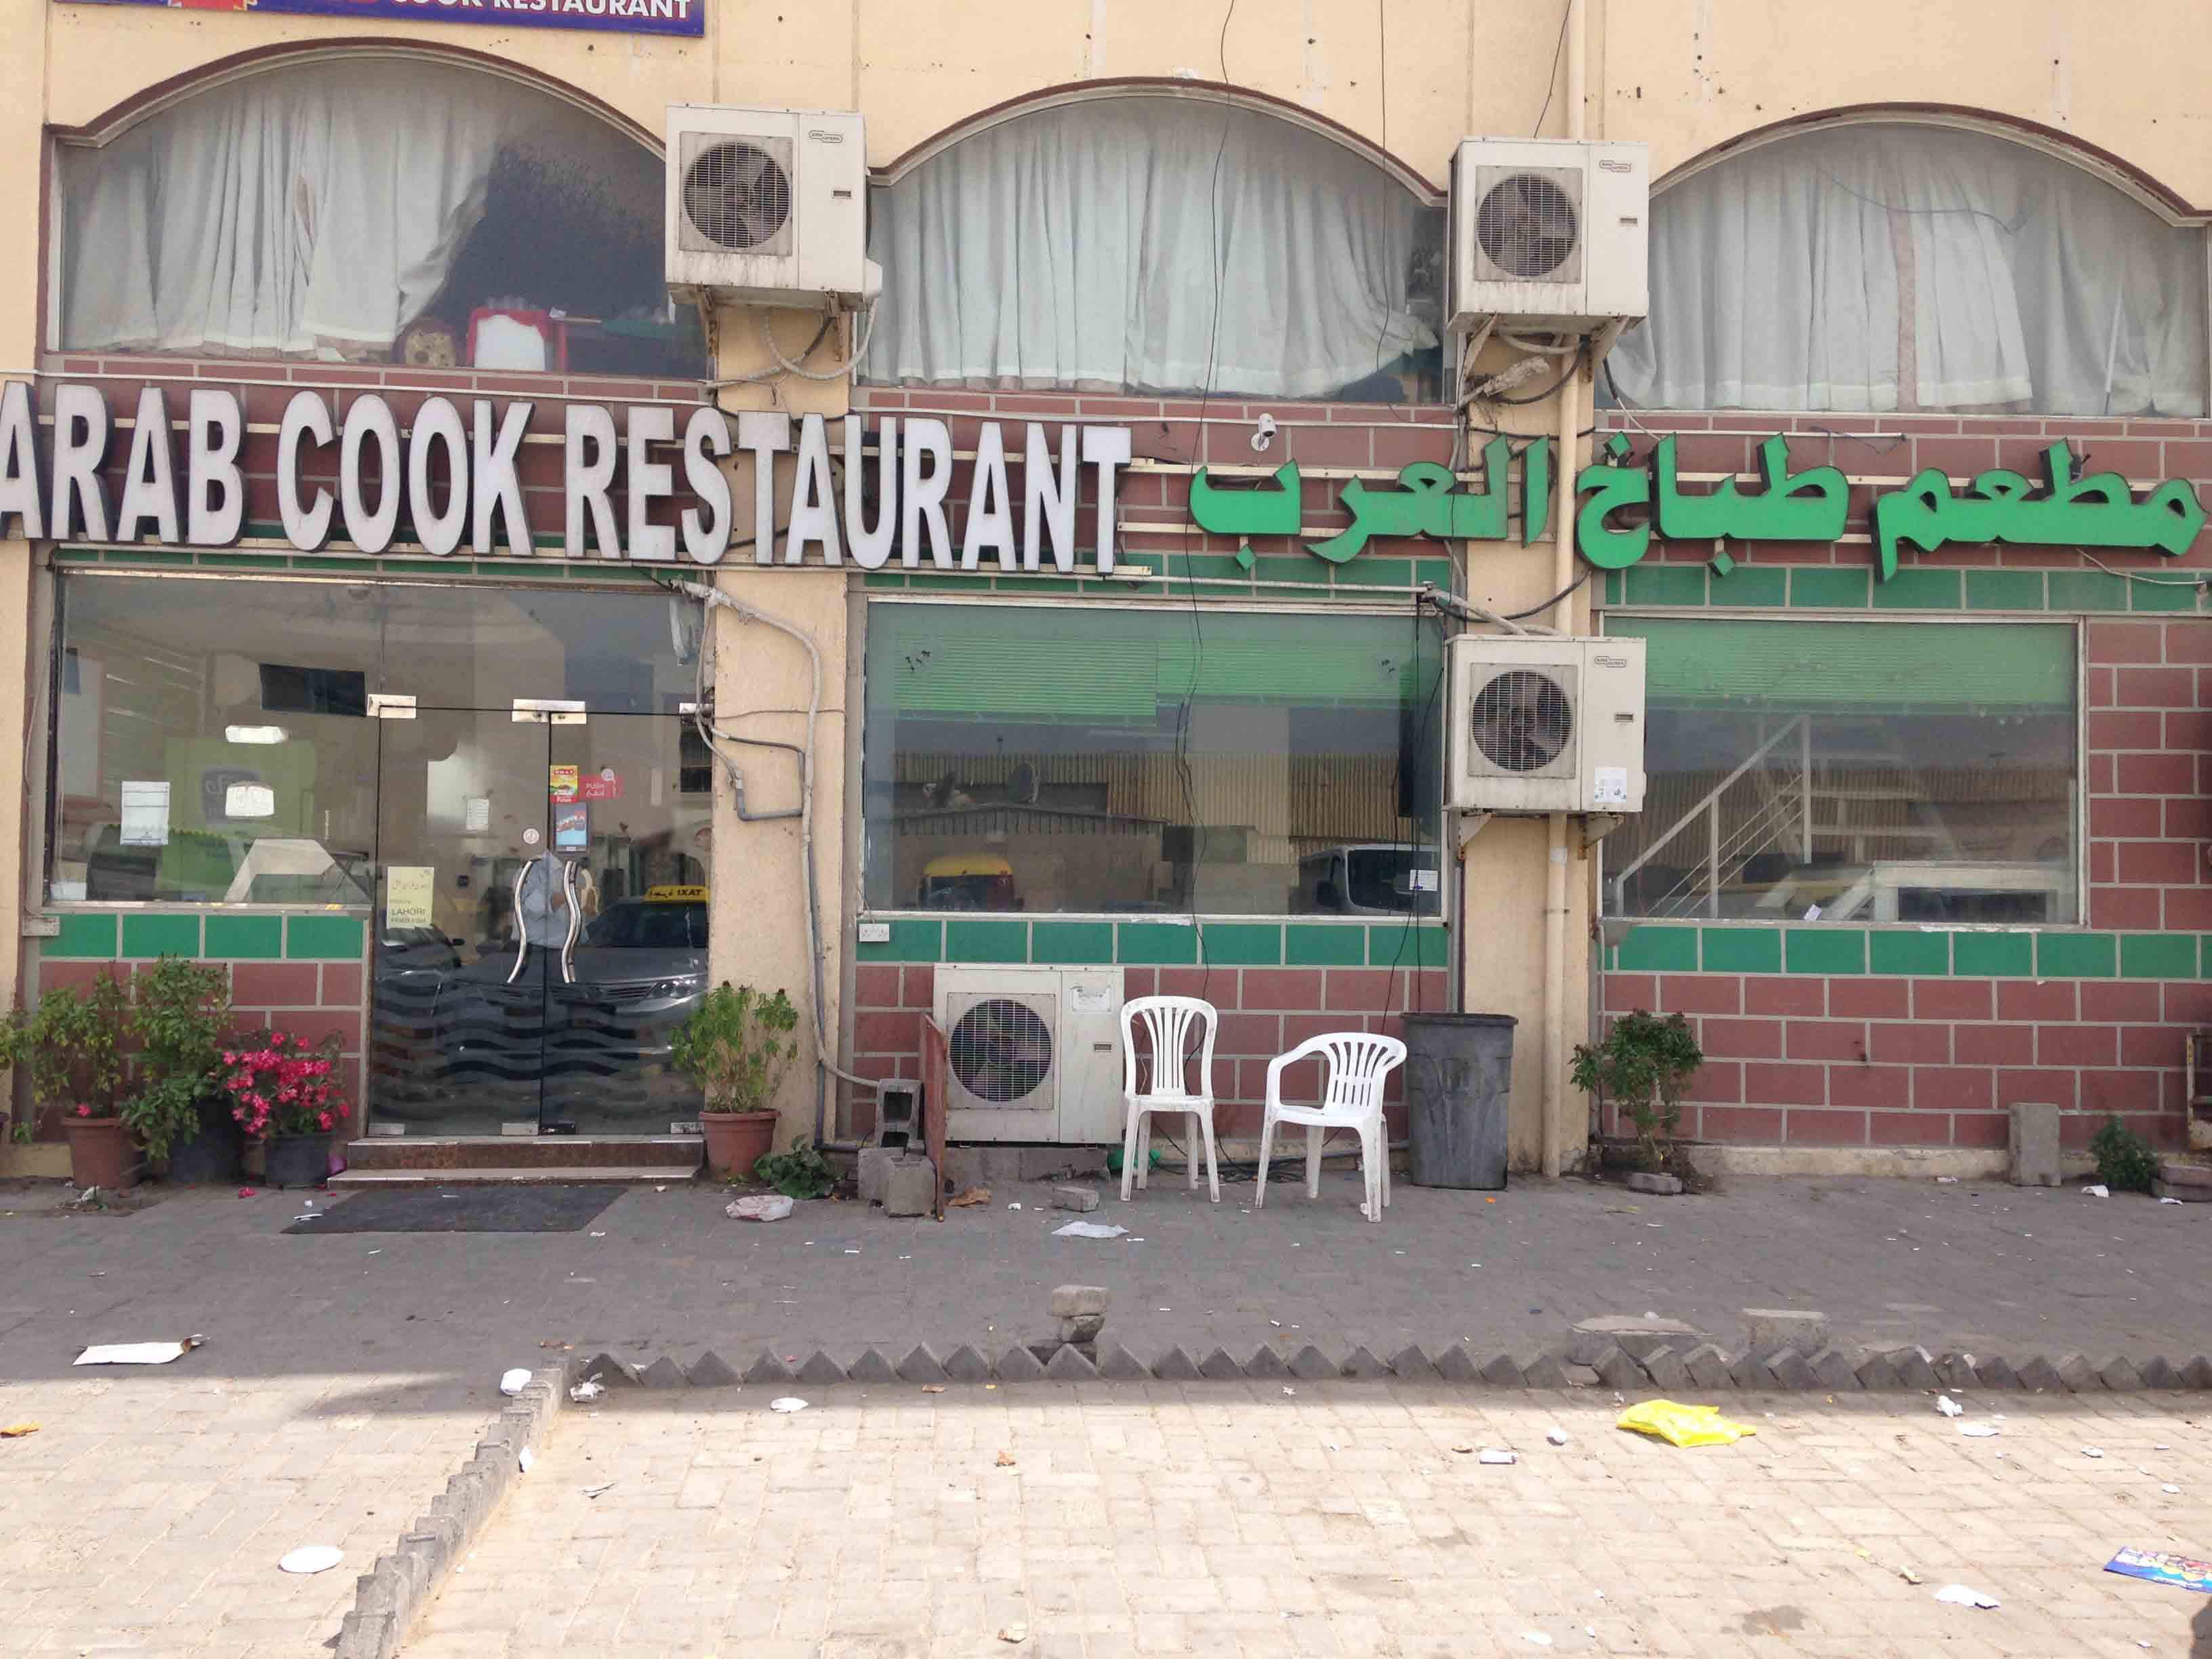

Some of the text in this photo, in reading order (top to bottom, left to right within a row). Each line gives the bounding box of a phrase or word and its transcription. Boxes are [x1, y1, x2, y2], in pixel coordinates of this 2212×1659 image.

[0, 381, 1132, 575] ARAB COOK RESTAURANT
[1576, 431, 1850, 577] طباخ
[1870, 438, 2209, 583] مطعم
